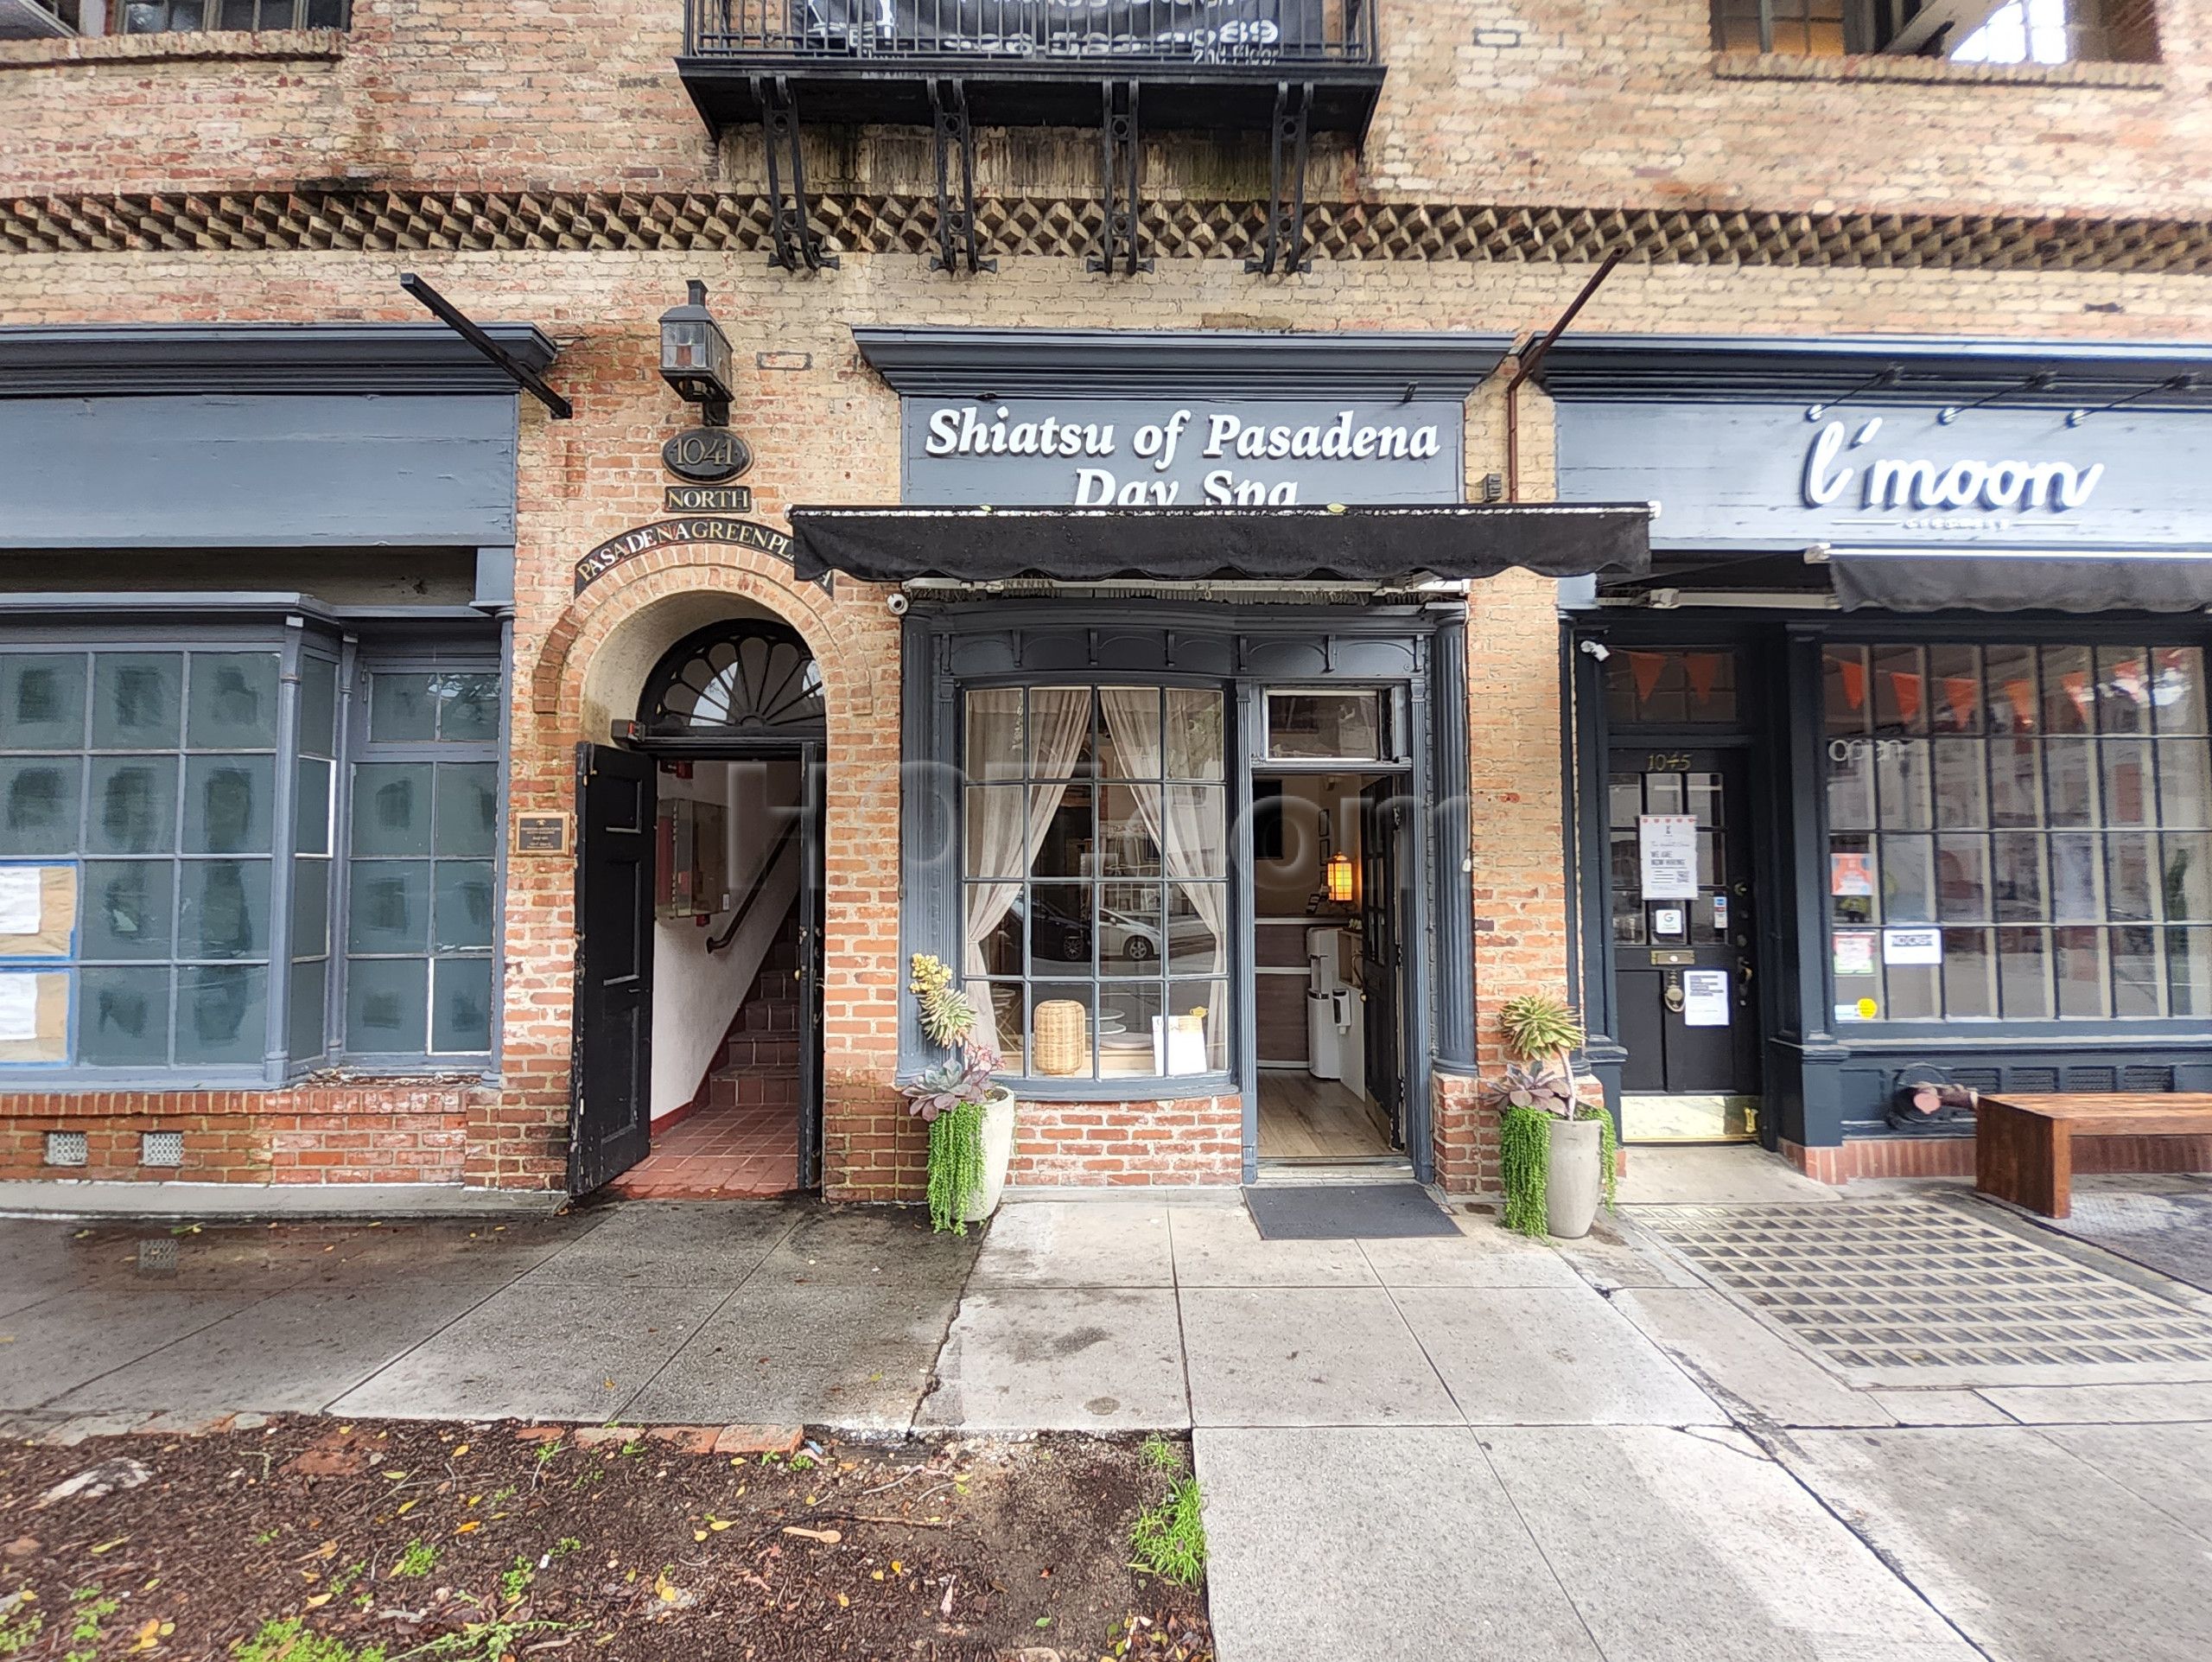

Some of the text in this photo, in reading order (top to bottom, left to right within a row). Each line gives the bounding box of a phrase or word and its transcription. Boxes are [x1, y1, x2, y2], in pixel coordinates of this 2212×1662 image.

[673, 437, 734, 467] 1041
[925, 406, 1441, 472] Shiatsu of Pasadena
[669, 491, 749, 508] NORTH
[576, 523, 690, 583] PASADENA
[692, 521, 768, 547] GREEN
[1647, 753, 1693, 772] 1045
